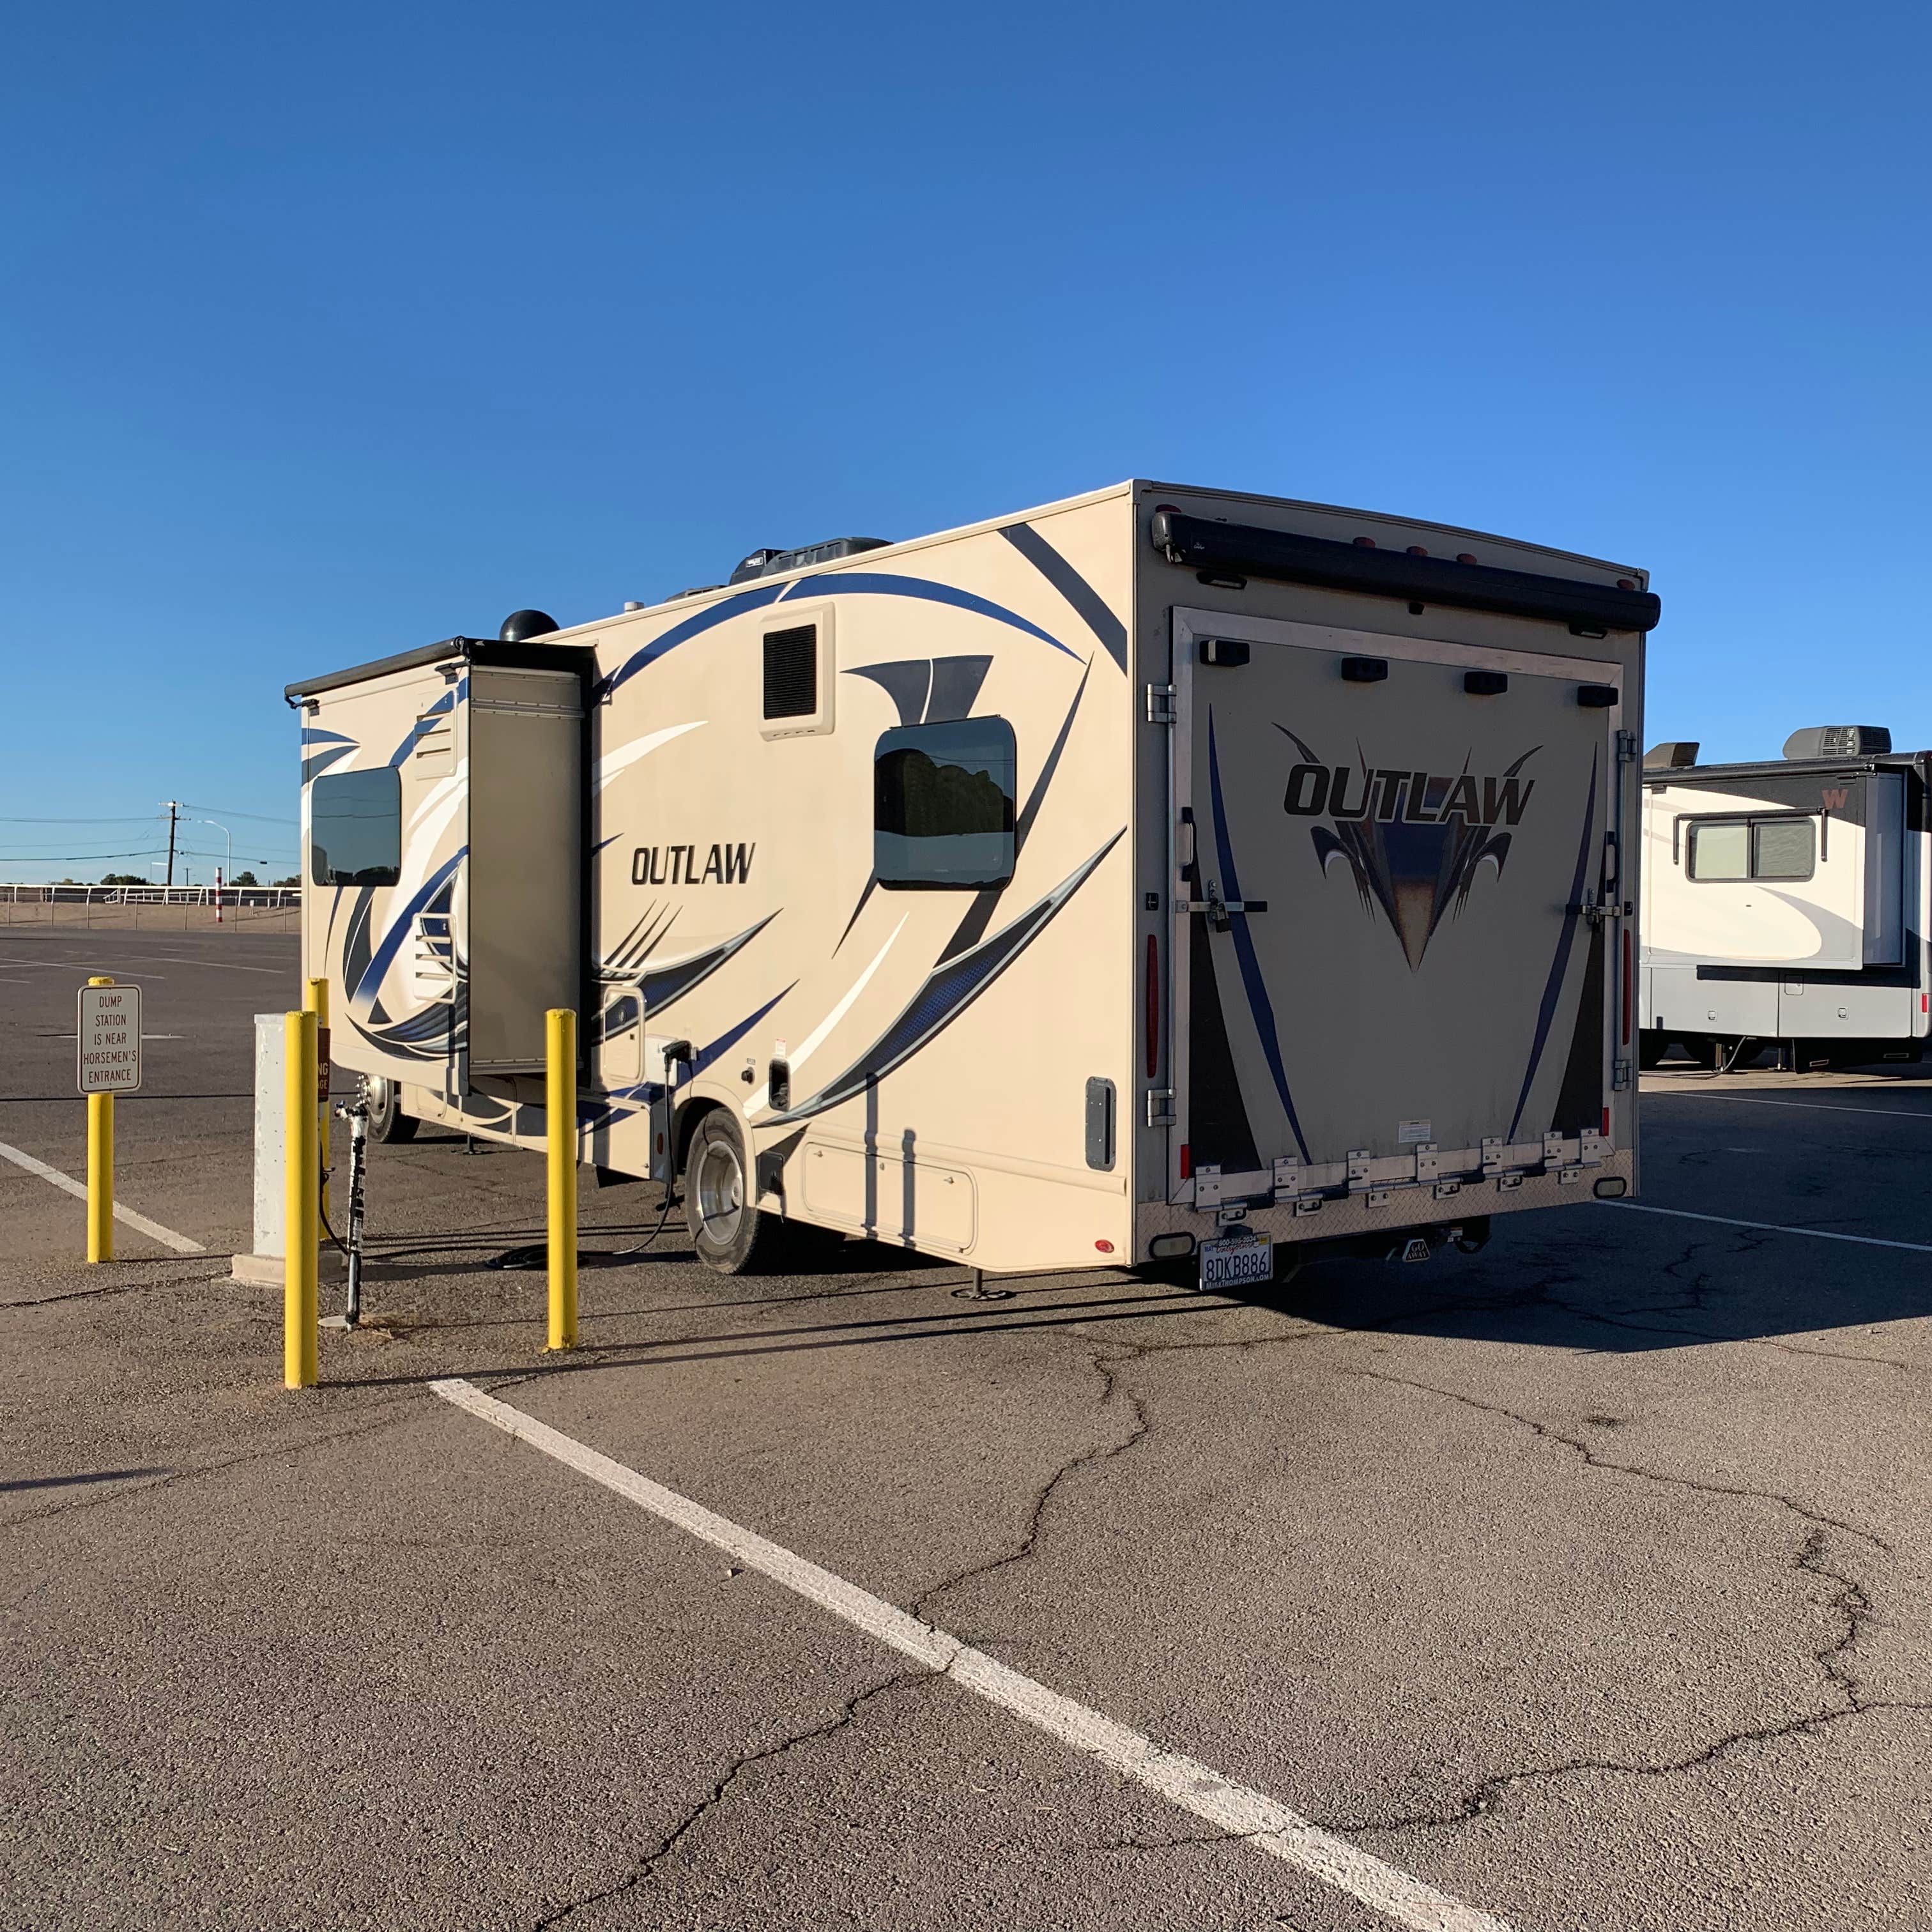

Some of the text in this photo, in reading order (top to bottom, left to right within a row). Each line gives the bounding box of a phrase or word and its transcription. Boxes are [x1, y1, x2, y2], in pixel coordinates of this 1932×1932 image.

[1284, 764, 1535, 825] OUTLAW
[1822, 789, 1848, 808] W
[632, 842, 756, 885] OUTLAW
[99, 995, 122, 1008] DUMP
[95, 1014, 126, 1027] STATION
[94, 1032, 126, 1045] IS NEAR
[83, 1050, 136, 1064] HORSEMEN'S
[89, 1069, 131, 1083] ENTRANCE
[1411, 1243, 1424, 1252] GO
[1407, 1251, 1426, 1259] AWAY
[1206, 1252, 1267, 1280] 8DKB886
